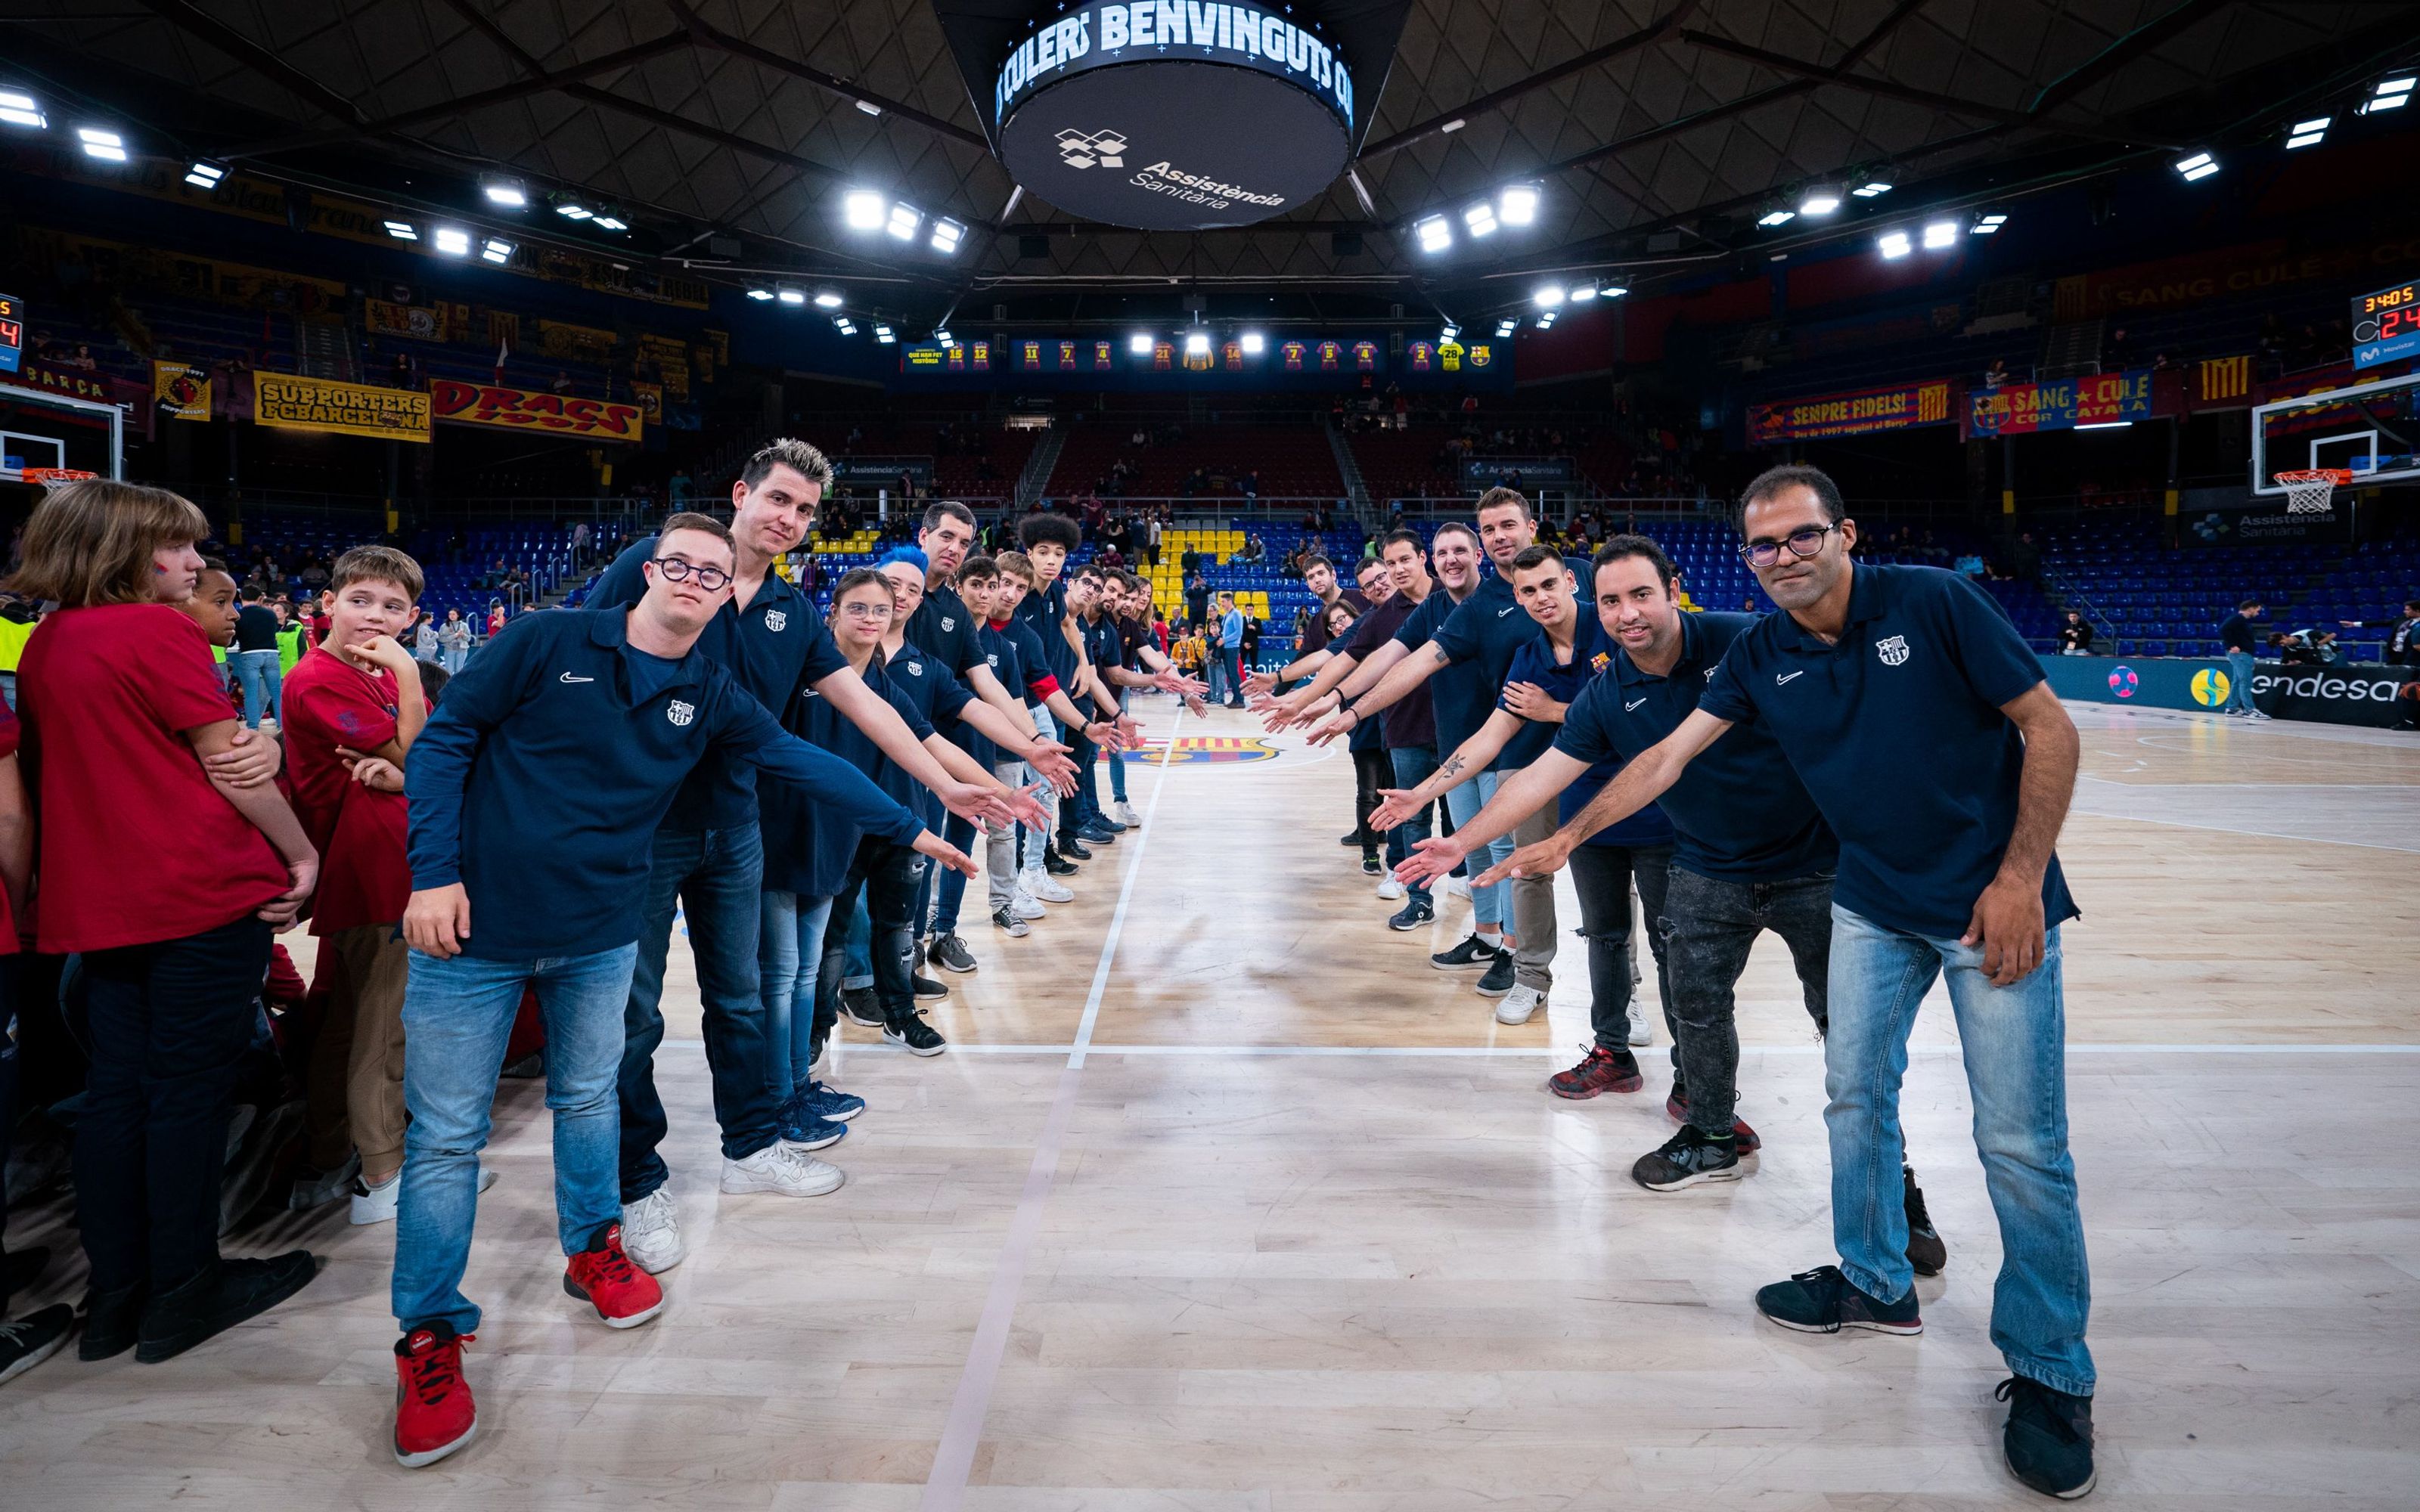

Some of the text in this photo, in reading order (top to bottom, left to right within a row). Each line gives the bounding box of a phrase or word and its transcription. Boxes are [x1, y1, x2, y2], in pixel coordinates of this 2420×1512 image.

[1004, 12, 1090, 101] CULERS
[1101, 0, 1331, 88] BENVINGUTS
[1129, 173, 1230, 209] Sanitària
[1143, 161, 1285, 206] Assistència
[2365, 287, 2413, 312] 34:05
[950, 349, 963, 359] 15
[975, 349, 987, 359] 12
[1025, 348, 1038, 358] 11
[1063, 348, 1071, 358] 7
[1099, 348, 1107, 358] 4
[1290, 349, 1298, 358] 7
[1417, 349, 1426, 359] 2
[1445, 350, 1457, 358] 28
[262, 382, 428, 416] SUPPORTERS
[433, 380, 638, 435] DRACS
[1793, 392, 1907, 426] SEMPRE FIDELS!
[2015, 387, 2069, 413] SANG
[262, 402, 429, 430] FCBARCELNA
[473, 411, 599, 432] 1991
[2251, 672, 2400, 702] endesa
